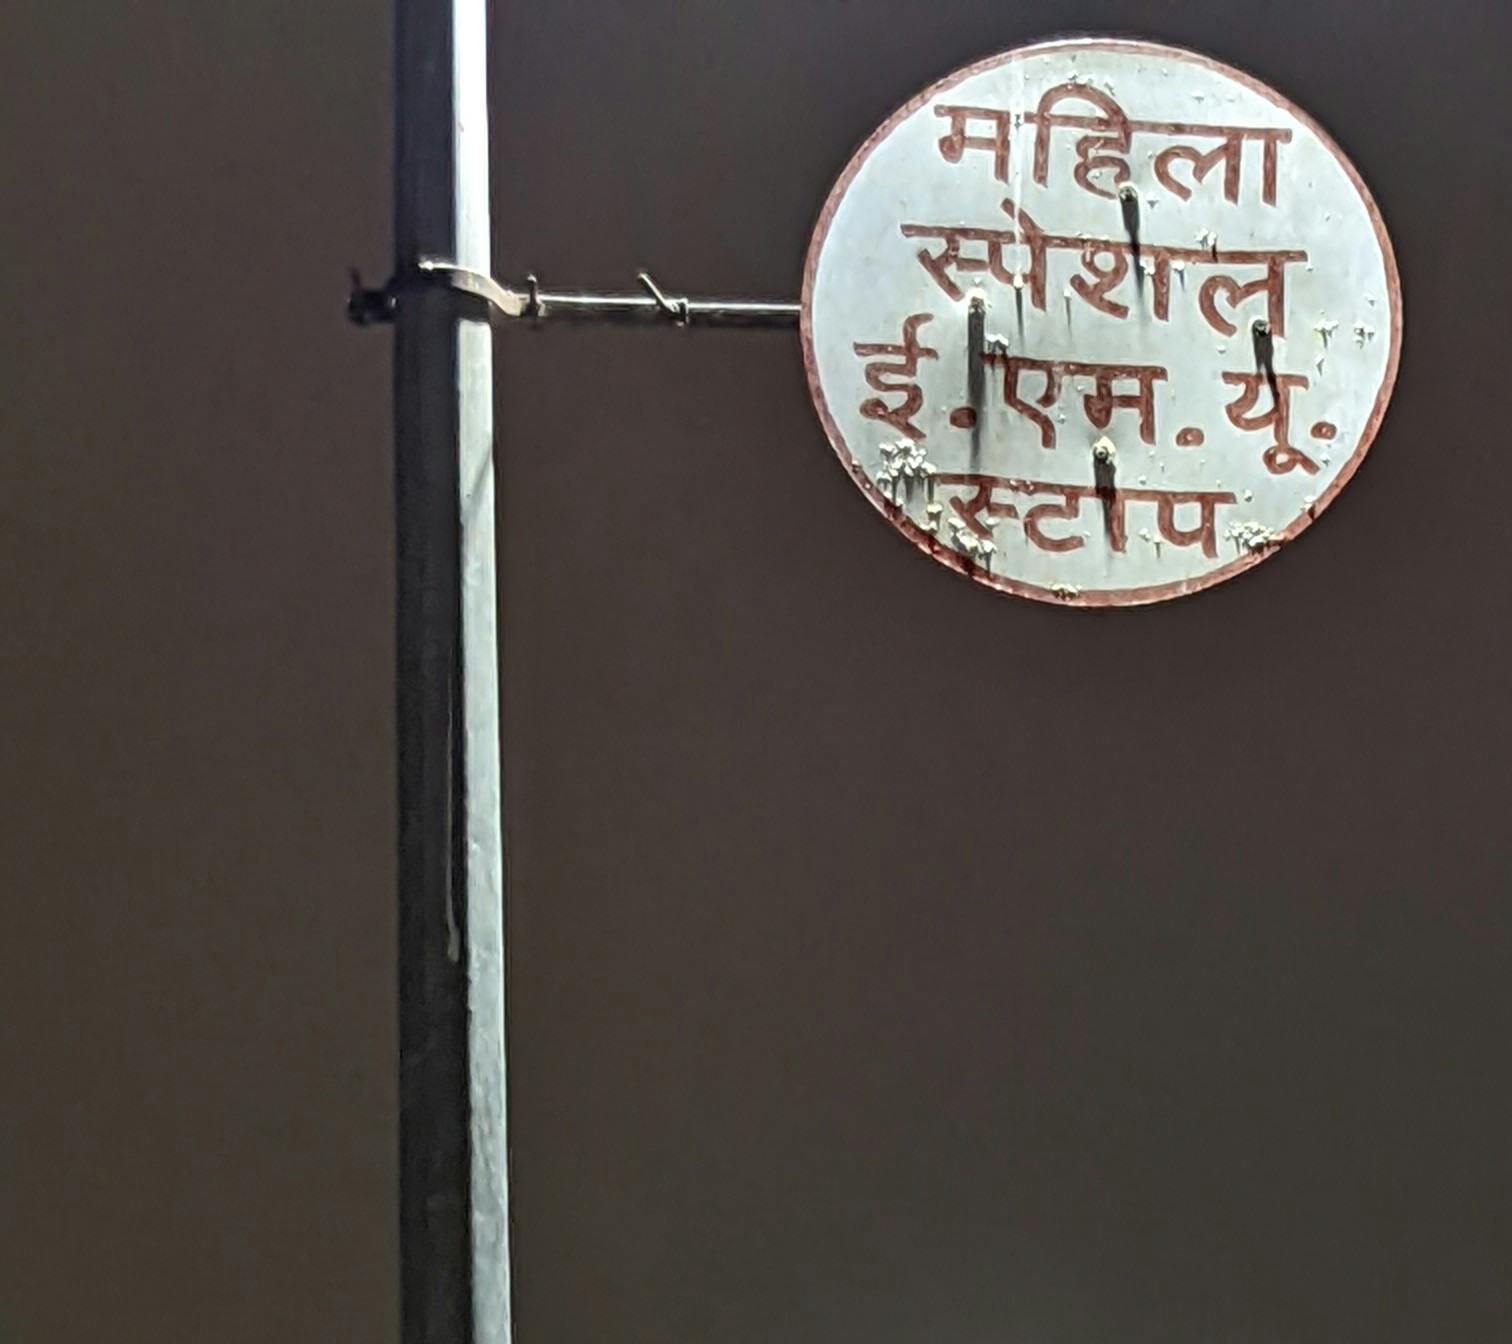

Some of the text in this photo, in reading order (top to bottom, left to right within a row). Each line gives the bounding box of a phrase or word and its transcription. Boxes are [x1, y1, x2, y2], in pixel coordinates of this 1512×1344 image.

[933, 82, 1293, 207] महिला
[900, 198, 1308, 338] स्पेशल
[931, 472, 1238, 558] स्टाप
